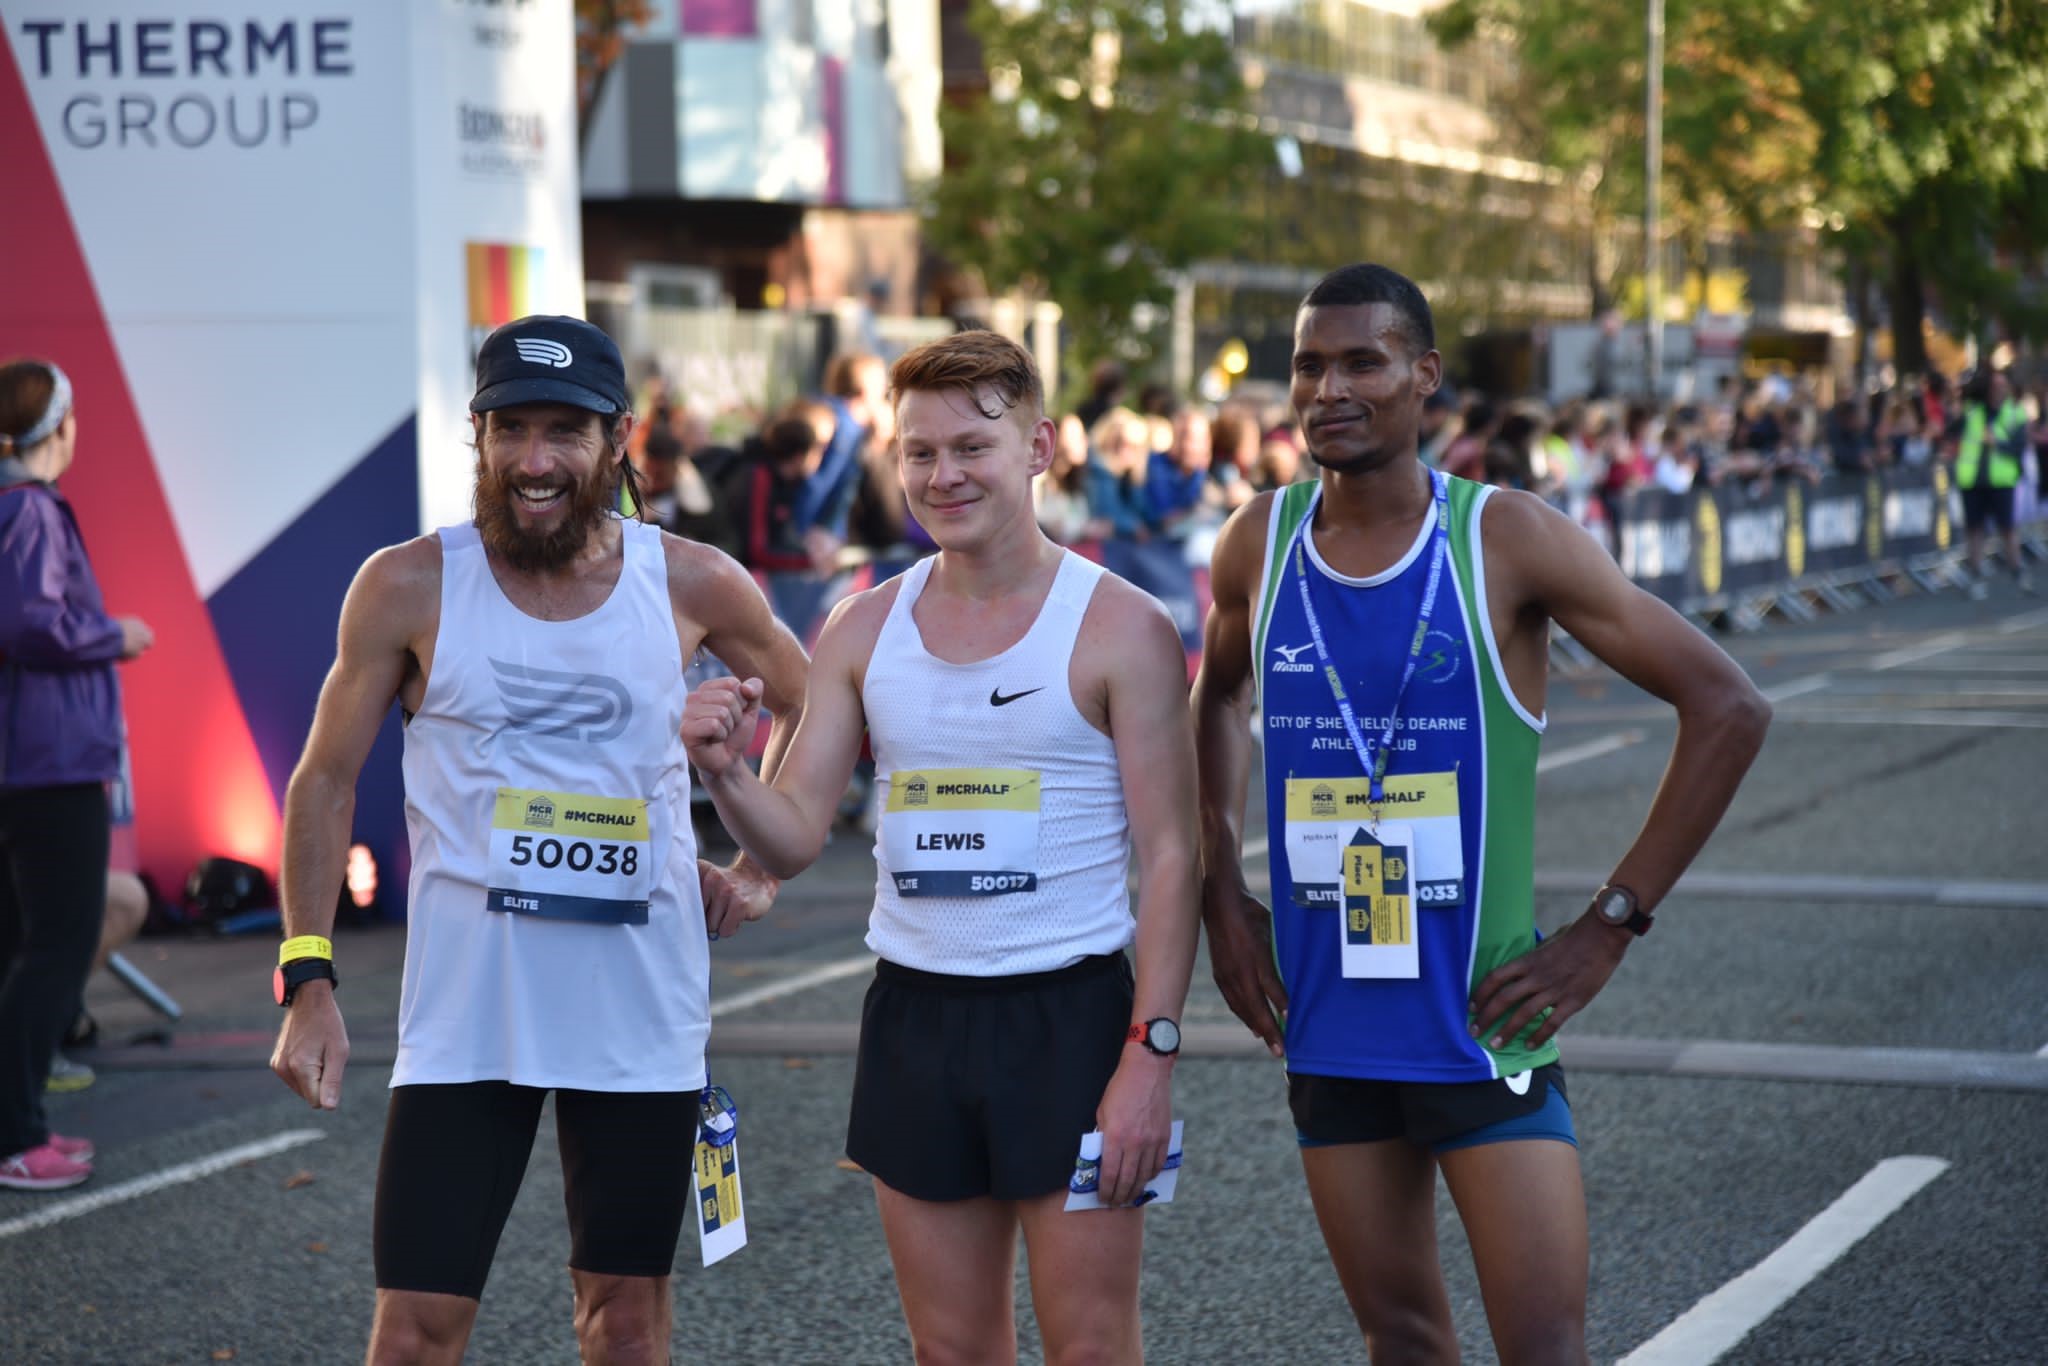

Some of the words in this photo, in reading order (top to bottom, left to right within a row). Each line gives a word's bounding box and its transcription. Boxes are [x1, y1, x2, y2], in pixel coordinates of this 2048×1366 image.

[22, 19, 355, 79] THERME
[61, 93, 320, 150] GROUP
[1269, 716, 1293, 729] CITY
[1296, 716, 1312, 729] OF
[1315, 717, 1389, 730] SHEIELD
[1408, 717, 1468, 731] DEARNE
[1311, 737, 1376, 750] ATHLEC
[906, 784, 926, 792] MCR
[936, 784, 1010, 796] #MCRHALF
[1313, 793, 1334, 802] MCR
[1345, 791, 1426, 805] #MHALF
[529, 804, 553, 815] MCR
[564, 810, 636, 826] #MCRHALF
[916, 833, 986, 851] LEWIS
[509, 835, 639, 876] 50038
[970, 875, 1029, 892] 50017
[1306, 890, 1341, 901] ELITE
[503, 896, 540, 911] ELITE
